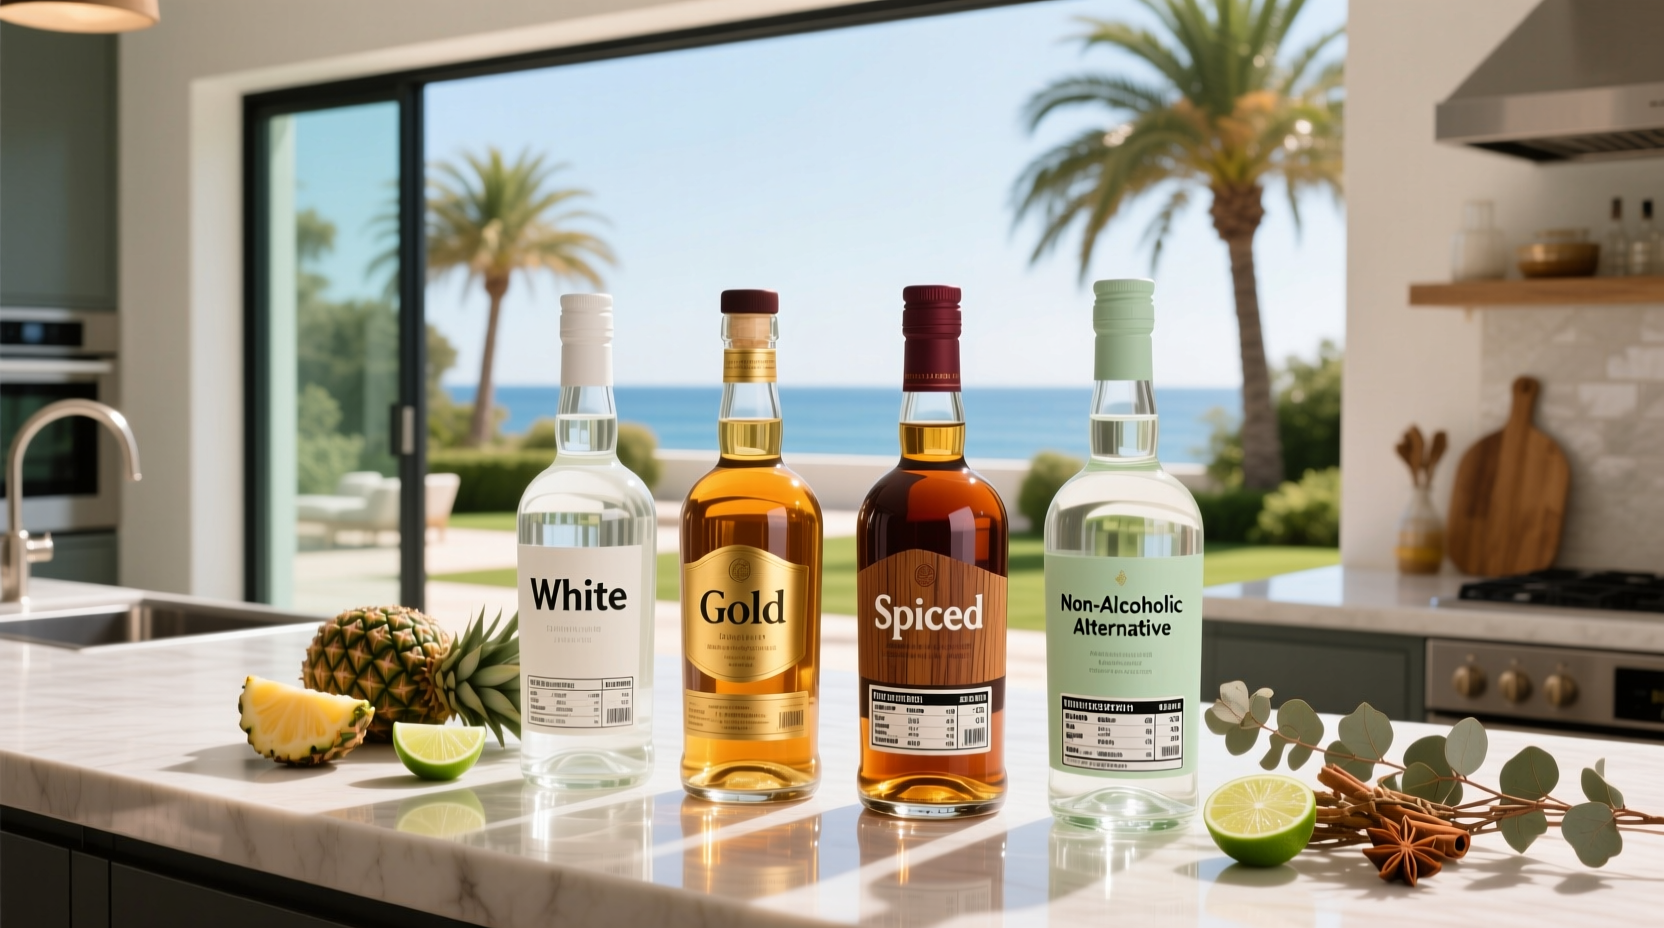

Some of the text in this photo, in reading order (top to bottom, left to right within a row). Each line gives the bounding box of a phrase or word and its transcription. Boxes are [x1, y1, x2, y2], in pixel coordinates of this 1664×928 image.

[530, 578, 627, 611] White
[700, 589, 786, 625] Gold
[1061, 593, 1183, 614] Non-Alcoholic
[875, 594, 983, 640] Spiced
[1073, 618, 1171, 637] Alternative
